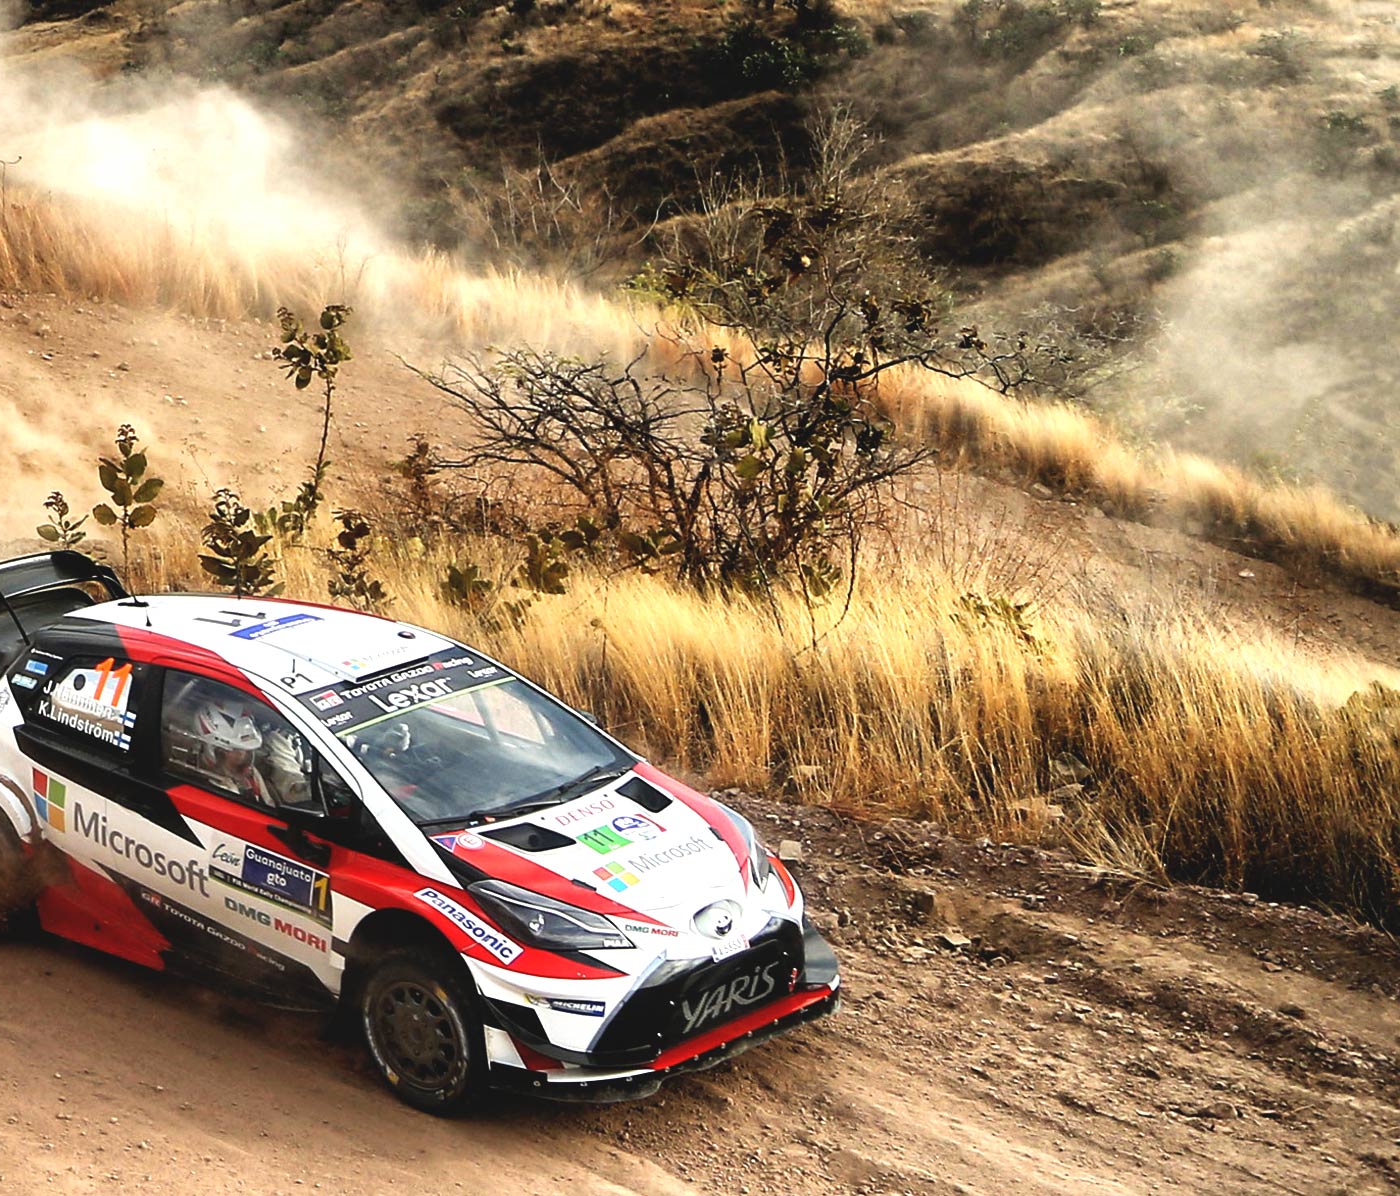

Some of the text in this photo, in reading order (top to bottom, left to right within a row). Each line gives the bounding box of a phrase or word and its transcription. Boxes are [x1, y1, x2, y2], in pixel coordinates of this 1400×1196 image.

[93, 656, 133, 708] 11
[279, 672, 314, 689] P1
[340, 678, 390, 700] TOYOTA
[431, 656, 474, 672] Racing
[369, 678, 453, 714] Lexar
[38, 700, 114, 744] K.Lindström
[555, 799, 615, 827] DENSO
[73, 802, 211, 899] Microsoft
[583, 828, 615, 847] 11
[627, 835, 713, 873] Microsoft
[245, 848, 312, 883] Guanajuato
[266, 872, 287, 887] gto
[314, 876, 329, 912] 1
[163, 902, 206, 931] TOYOTA
[224, 896, 327, 953] DMG MORI
[420, 890, 514, 959] Panasonic
[625, 924, 679, 938] DMG MORI
[551, 1000, 605, 1013] MICHELIN
